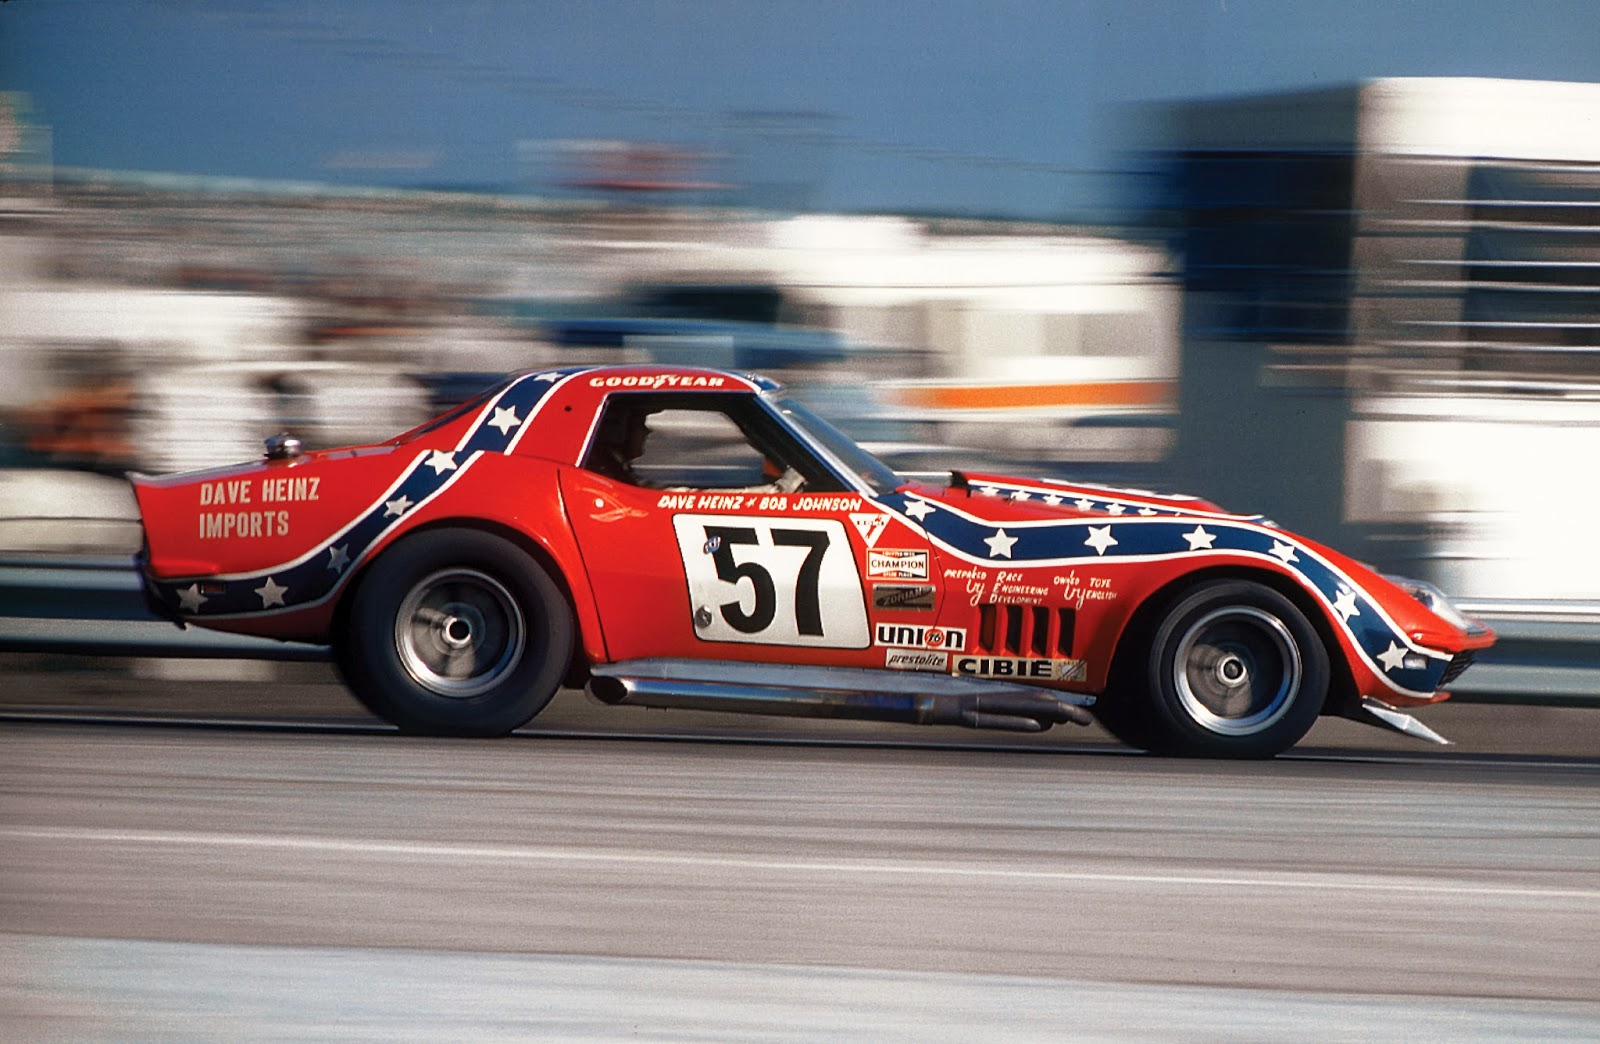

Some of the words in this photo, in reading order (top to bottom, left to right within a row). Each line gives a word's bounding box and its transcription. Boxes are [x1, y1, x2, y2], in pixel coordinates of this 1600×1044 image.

[589, 374, 725, 389] GOODYEAR
[200, 480, 252, 505] DAVE
[262, 477, 320, 501] HEINZ
[657, 495, 696, 510] DAVE
[697, 495, 745, 510] HEINZ
[759, 496, 787, 511] BOB
[792, 496, 862, 512] JOHNSON
[199, 510, 290, 539] IMPORTS
[871, 559, 924, 569] CHAMPION
[703, 525, 831, 638] 57
[996, 571, 1023, 583] RACE
[888, 654, 945, 666] prestolite
